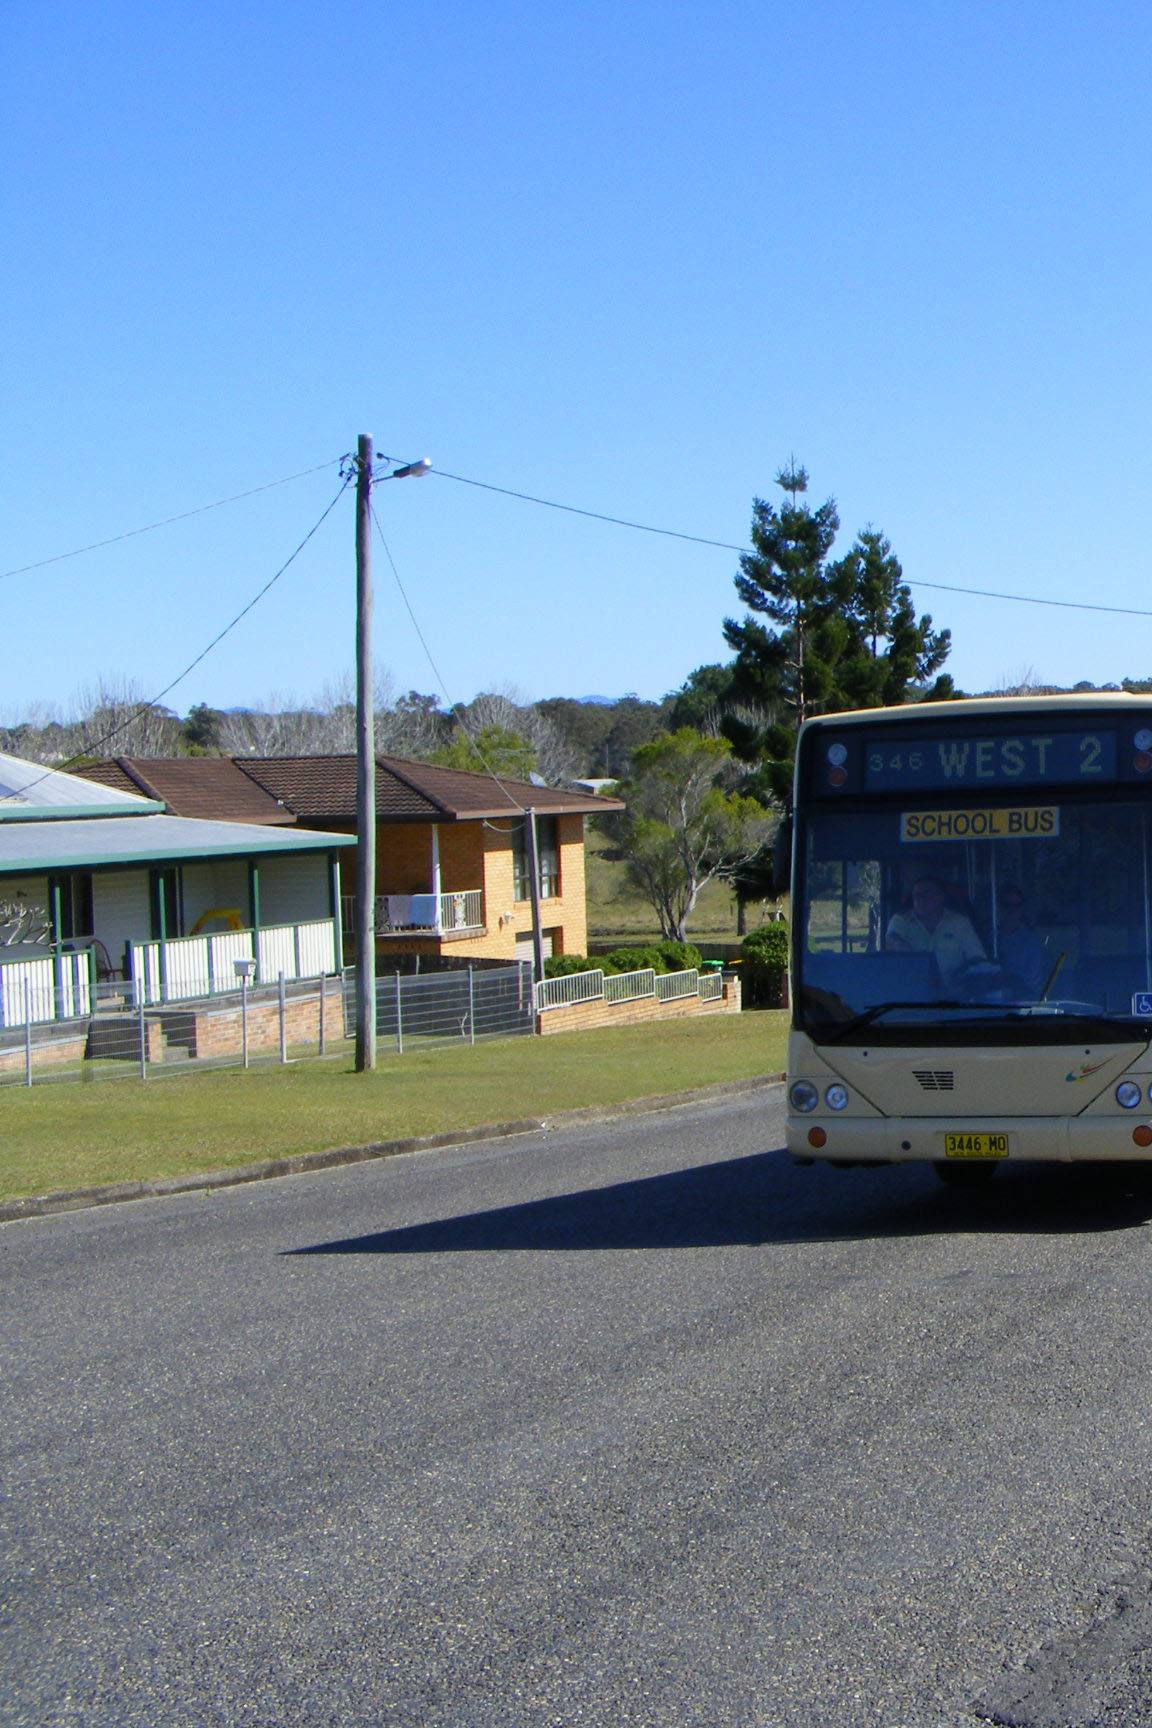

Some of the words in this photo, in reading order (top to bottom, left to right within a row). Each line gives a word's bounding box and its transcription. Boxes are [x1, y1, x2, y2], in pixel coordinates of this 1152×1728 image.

[869, 752, 923, 772] 346
[938, 738, 1053, 779] WEST
[1079, 736, 1102, 774] 2
[906, 812, 1001, 837] SCHOOL
[1008, 810, 1054, 833] BUS
